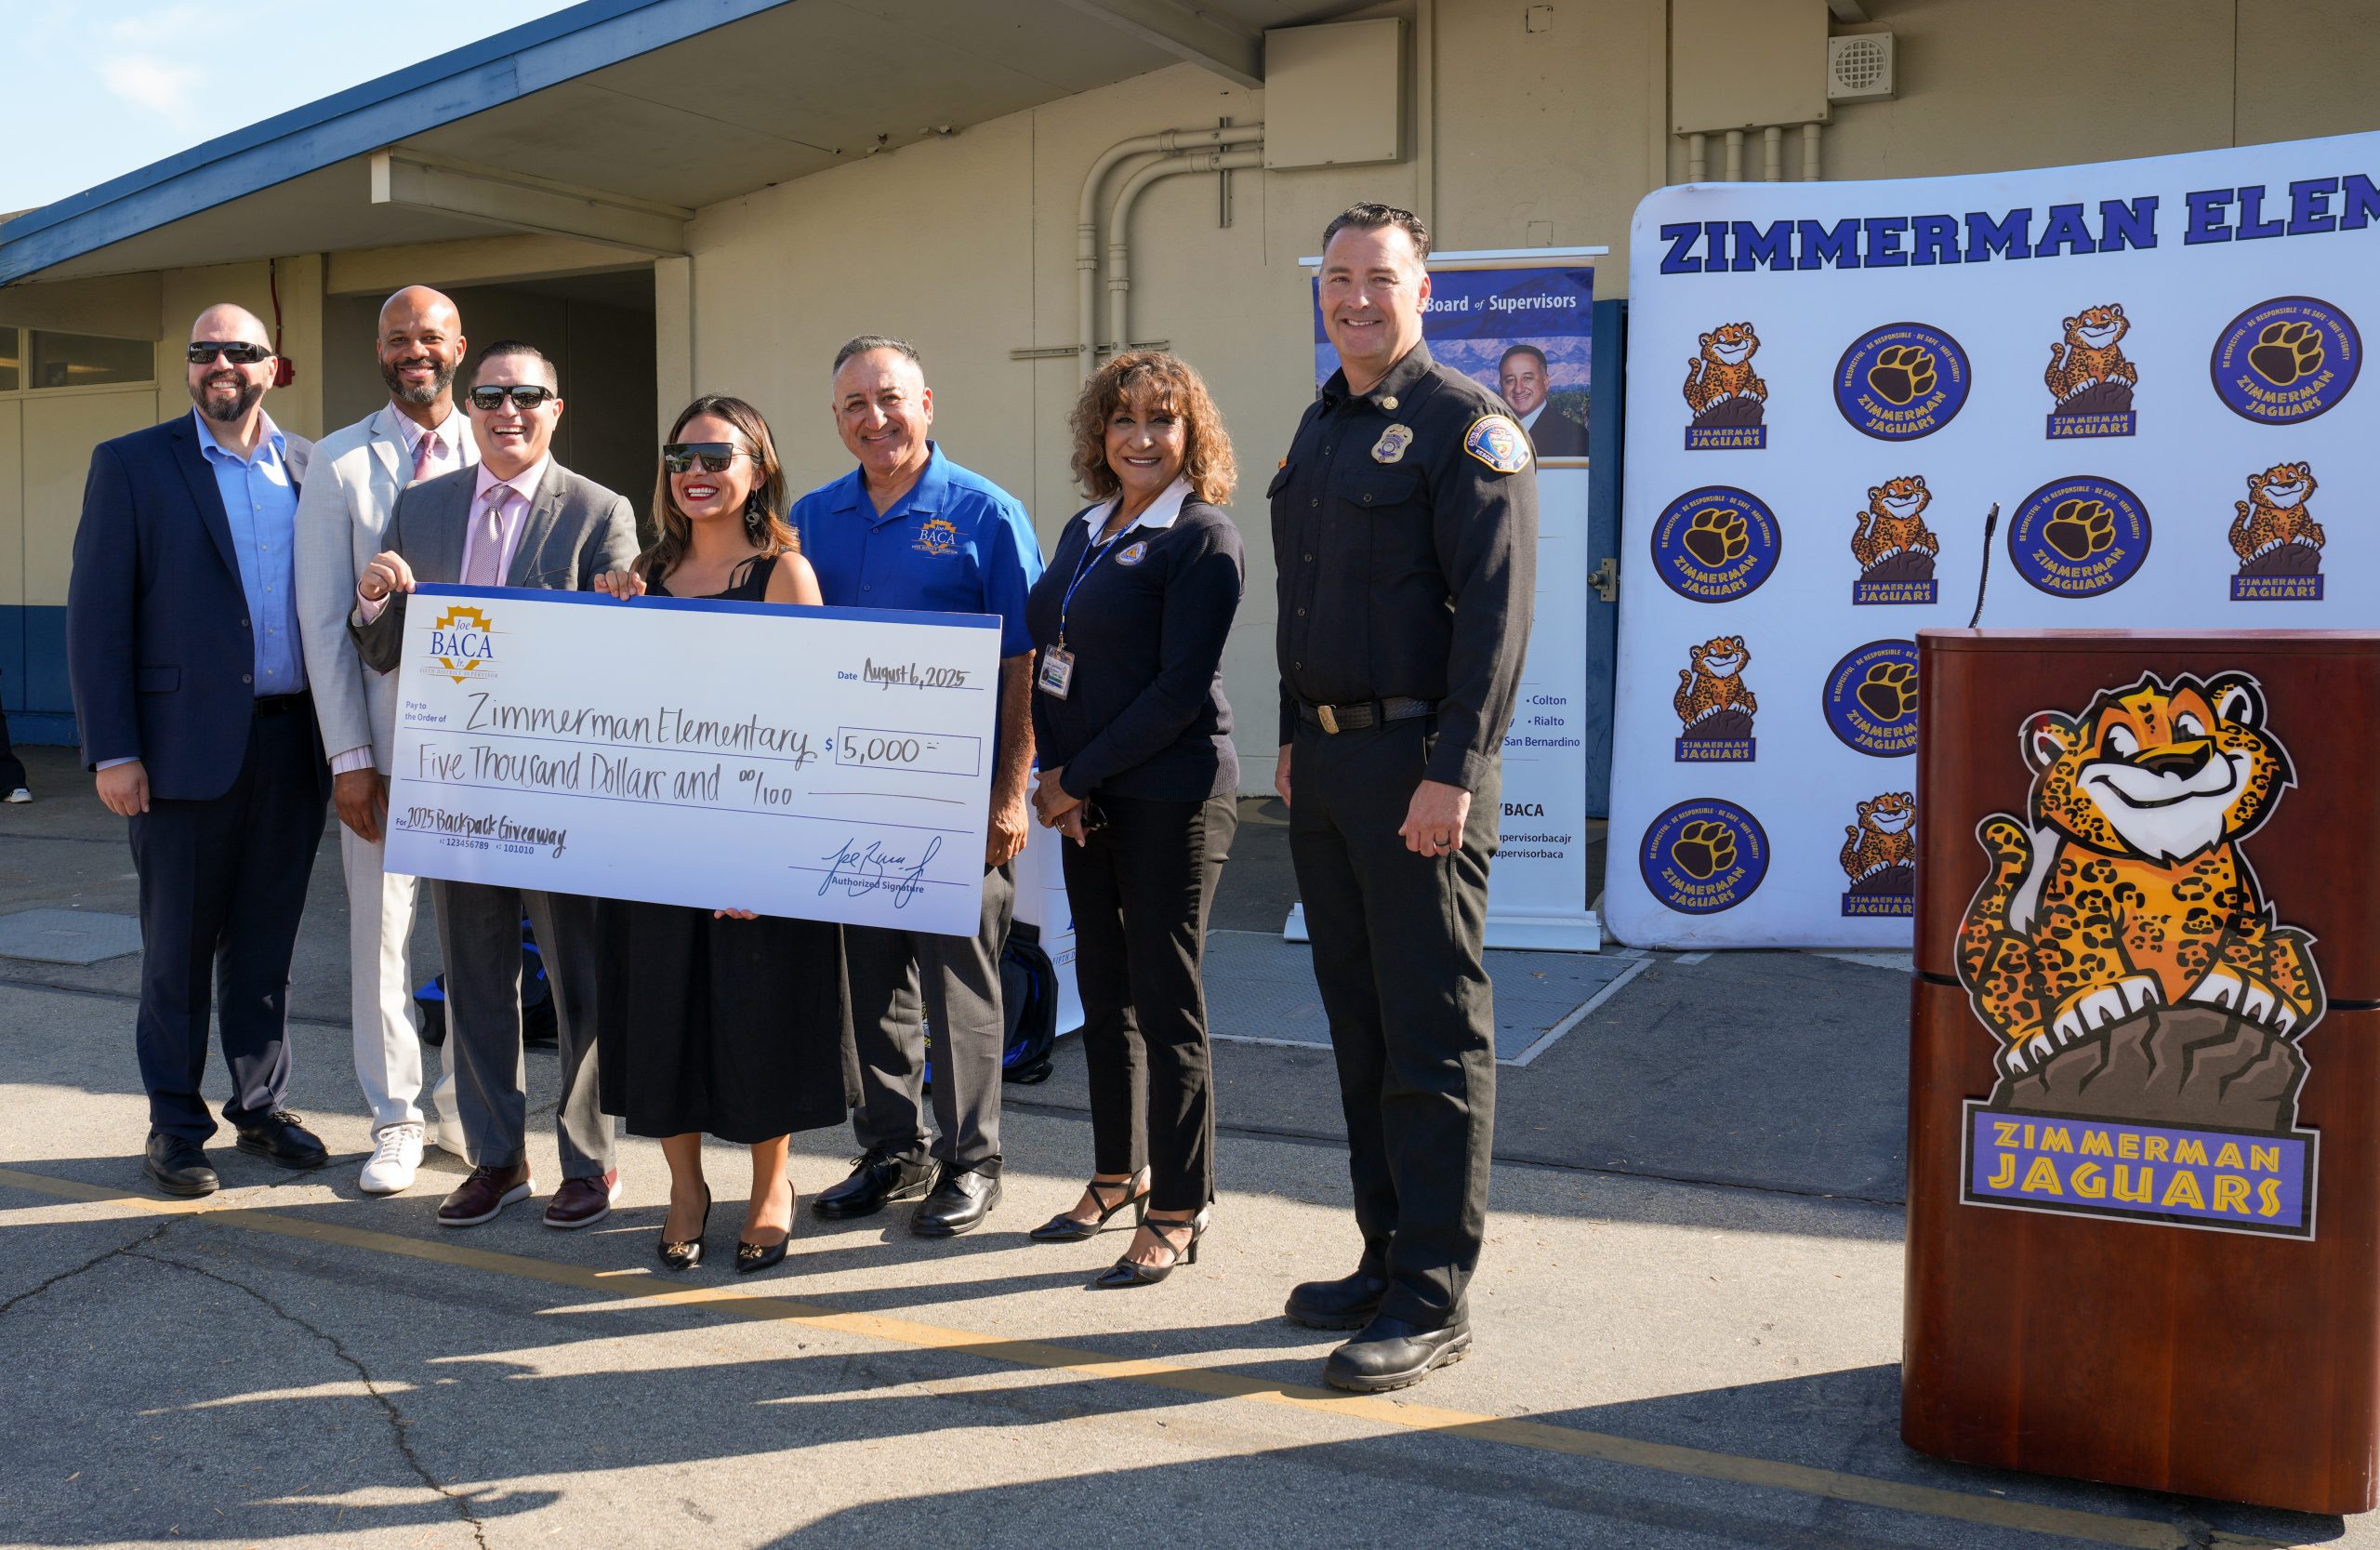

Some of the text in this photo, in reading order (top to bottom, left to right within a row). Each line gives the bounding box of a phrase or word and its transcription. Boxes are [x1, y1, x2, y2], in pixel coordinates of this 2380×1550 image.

[1660, 196, 2159, 274] ZIMMERMAN
[1426, 293, 1577, 313] Board of Supervisors
[2247, 319, 2256, 327] BE
[2256, 307, 2297, 322] RESPONSIBLE
[2311, 311, 2327, 321] SAFE
[1867, 341, 1874, 350] BE
[1874, 332, 1911, 345] RESPONSIBLE
[1925, 336, 1938, 345] SAFE
[2236, 370, 2334, 404] ZIMMERMAN
[1858, 391, 1946, 420] ZIMMERMAN
[2246, 396, 2321, 416] JAGUARS
[1867, 416, 1935, 433] JAGUARS
[2055, 415, 2128, 424] ZIMMERMAN
[2053, 423, 2128, 435] JAGUARS
[1691, 436, 1760, 446] JAGUARS
[2051, 486, 2089, 498] RESPONSIBLE
[2104, 490, 2118, 500] SAFE
[1690, 496, 1726, 508] RESPONSIBLE
[1738, 500, 1751, 510] SAFE
[919, 530, 956, 545] BACA
[1673, 554, 1757, 583] ZIMMERMAN
[2032, 547, 2125, 577] ZIMMERMAN
[1682, 578, 1747, 595] JAGUARS
[2042, 572, 2113, 590] JAGUARS
[1859, 591, 1931, 601] JAGUARS
[2238, 587, 2316, 596] JAGUARS
[456, 619, 470, 631] Joe
[430, 631, 494, 658] BACA
[1864, 649, 1900, 660] RESPONSIBLE
[838, 671, 857, 681] Date
[926, 667, 972, 688] 2025
[405, 701, 427, 710] Pay to
[1532, 696, 1567, 705] Colton
[405, 712, 446, 722] the Order of
[1534, 716, 1565, 725] Rialto
[1846, 709, 1917, 737] ZIMMERM
[467, 692, 818, 772] Zimmerman Elementary
[826, 737, 833, 751] $
[1504, 736, 1580, 747] San Bernardino
[1855, 734, 1917, 749] JAGUAR
[1681, 749, 1749, 758] JAGUARS
[418, 744, 465, 780] Five
[469, 746, 581, 789] Thousand
[673, 762, 721, 801] and
[1679, 808, 1713, 819] RESPONSIBLE
[1726, 813, 1739, 822] SAFE
[407, 807, 567, 859] 2025 Backpack Giveaway
[1499, 833, 1571, 845] pervisorbacajr
[1495, 849, 1564, 859] upervisorbaca
[832, 876, 924, 893] Authorized Signature
[1661, 867, 1746, 894] ZIMMERMAN
[1670, 890, 1735, 907] JAGUARS
[1848, 904, 1911, 913] JAGUAR
[1993, 1121, 2281, 1172] ZIMMERMAN
[1988, 1153, 2282, 1218] JAGUARS
